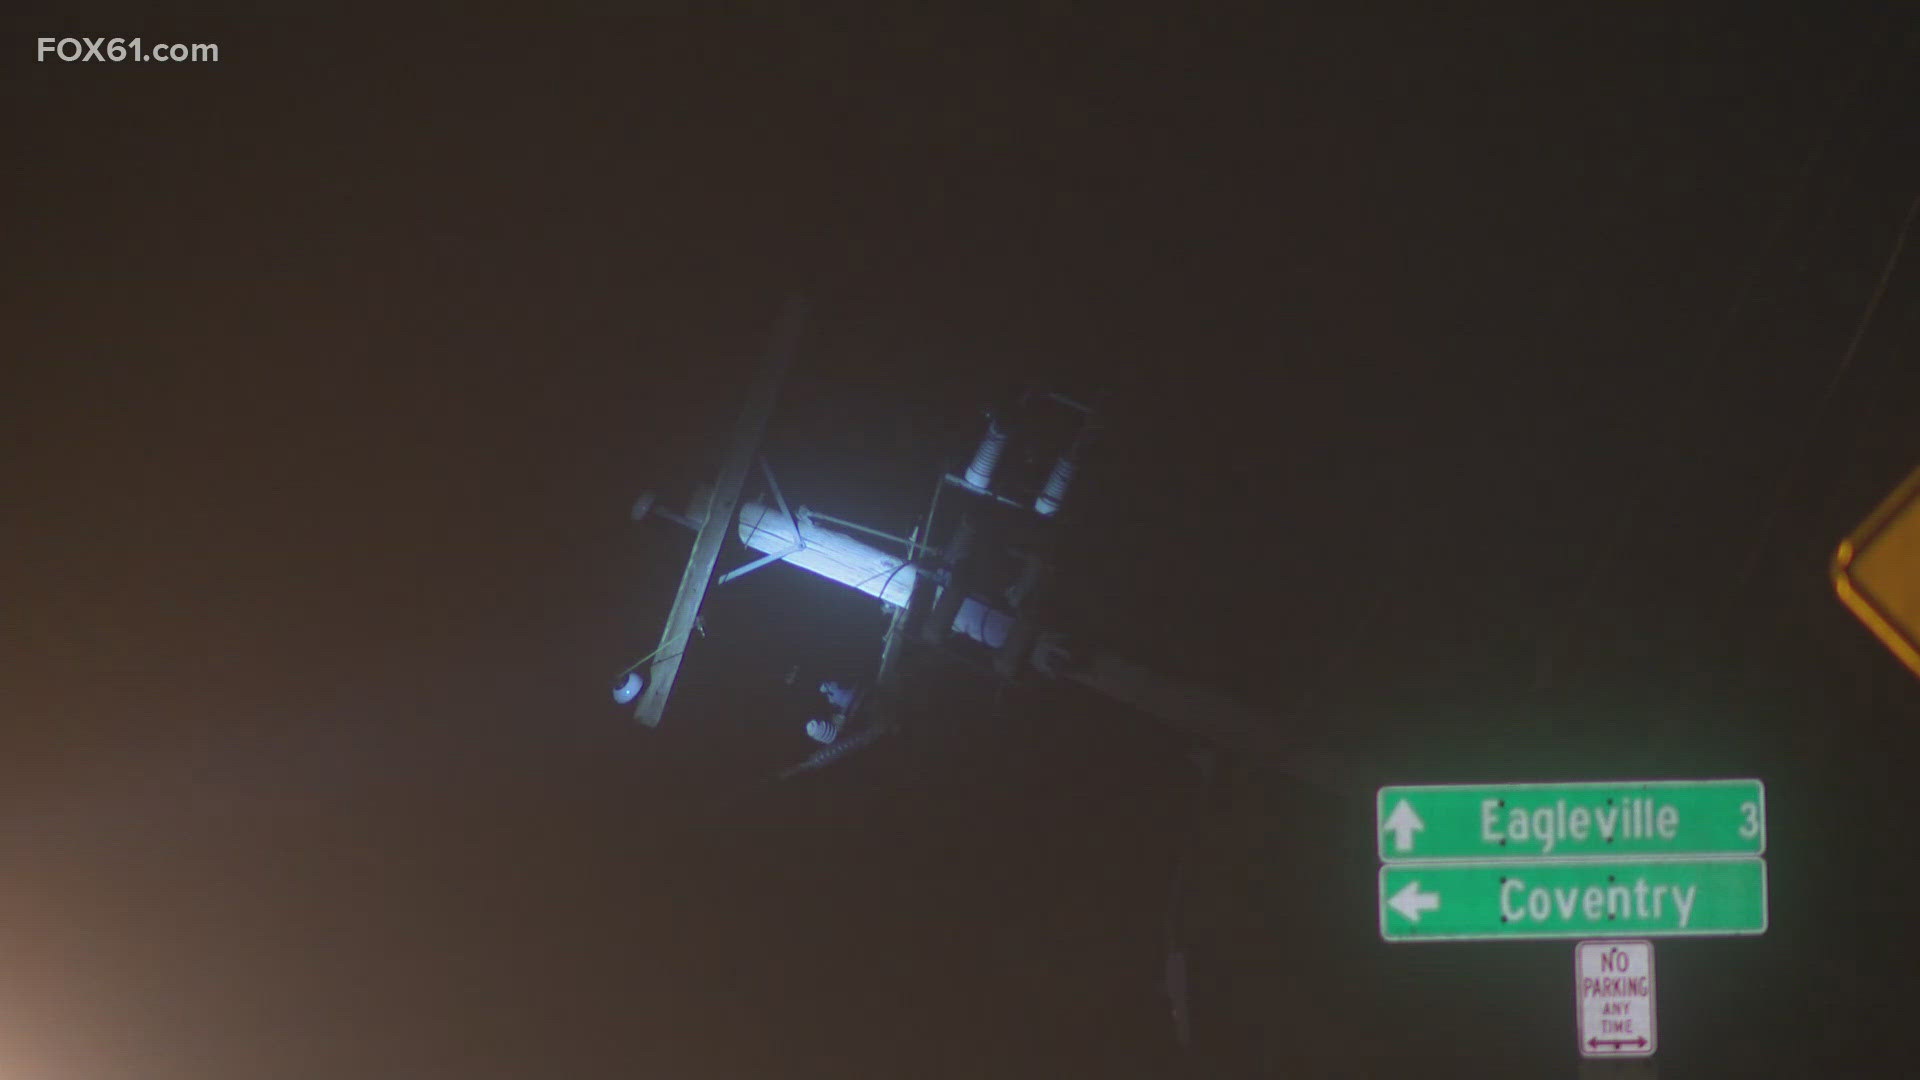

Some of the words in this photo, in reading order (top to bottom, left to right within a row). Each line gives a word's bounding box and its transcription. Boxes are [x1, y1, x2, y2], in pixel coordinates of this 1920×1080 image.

[1481, 799, 1680, 853] Eagleville
[1738, 801, 1760, 839] 3
[1501, 878, 1696, 928] Coventry
[1601, 951, 1630, 972] NO
[1584, 976, 1648, 997] PARKING
[1602, 1002, 1631, 1015] ANY
[1602, 1019, 1633, 1033] TIME
